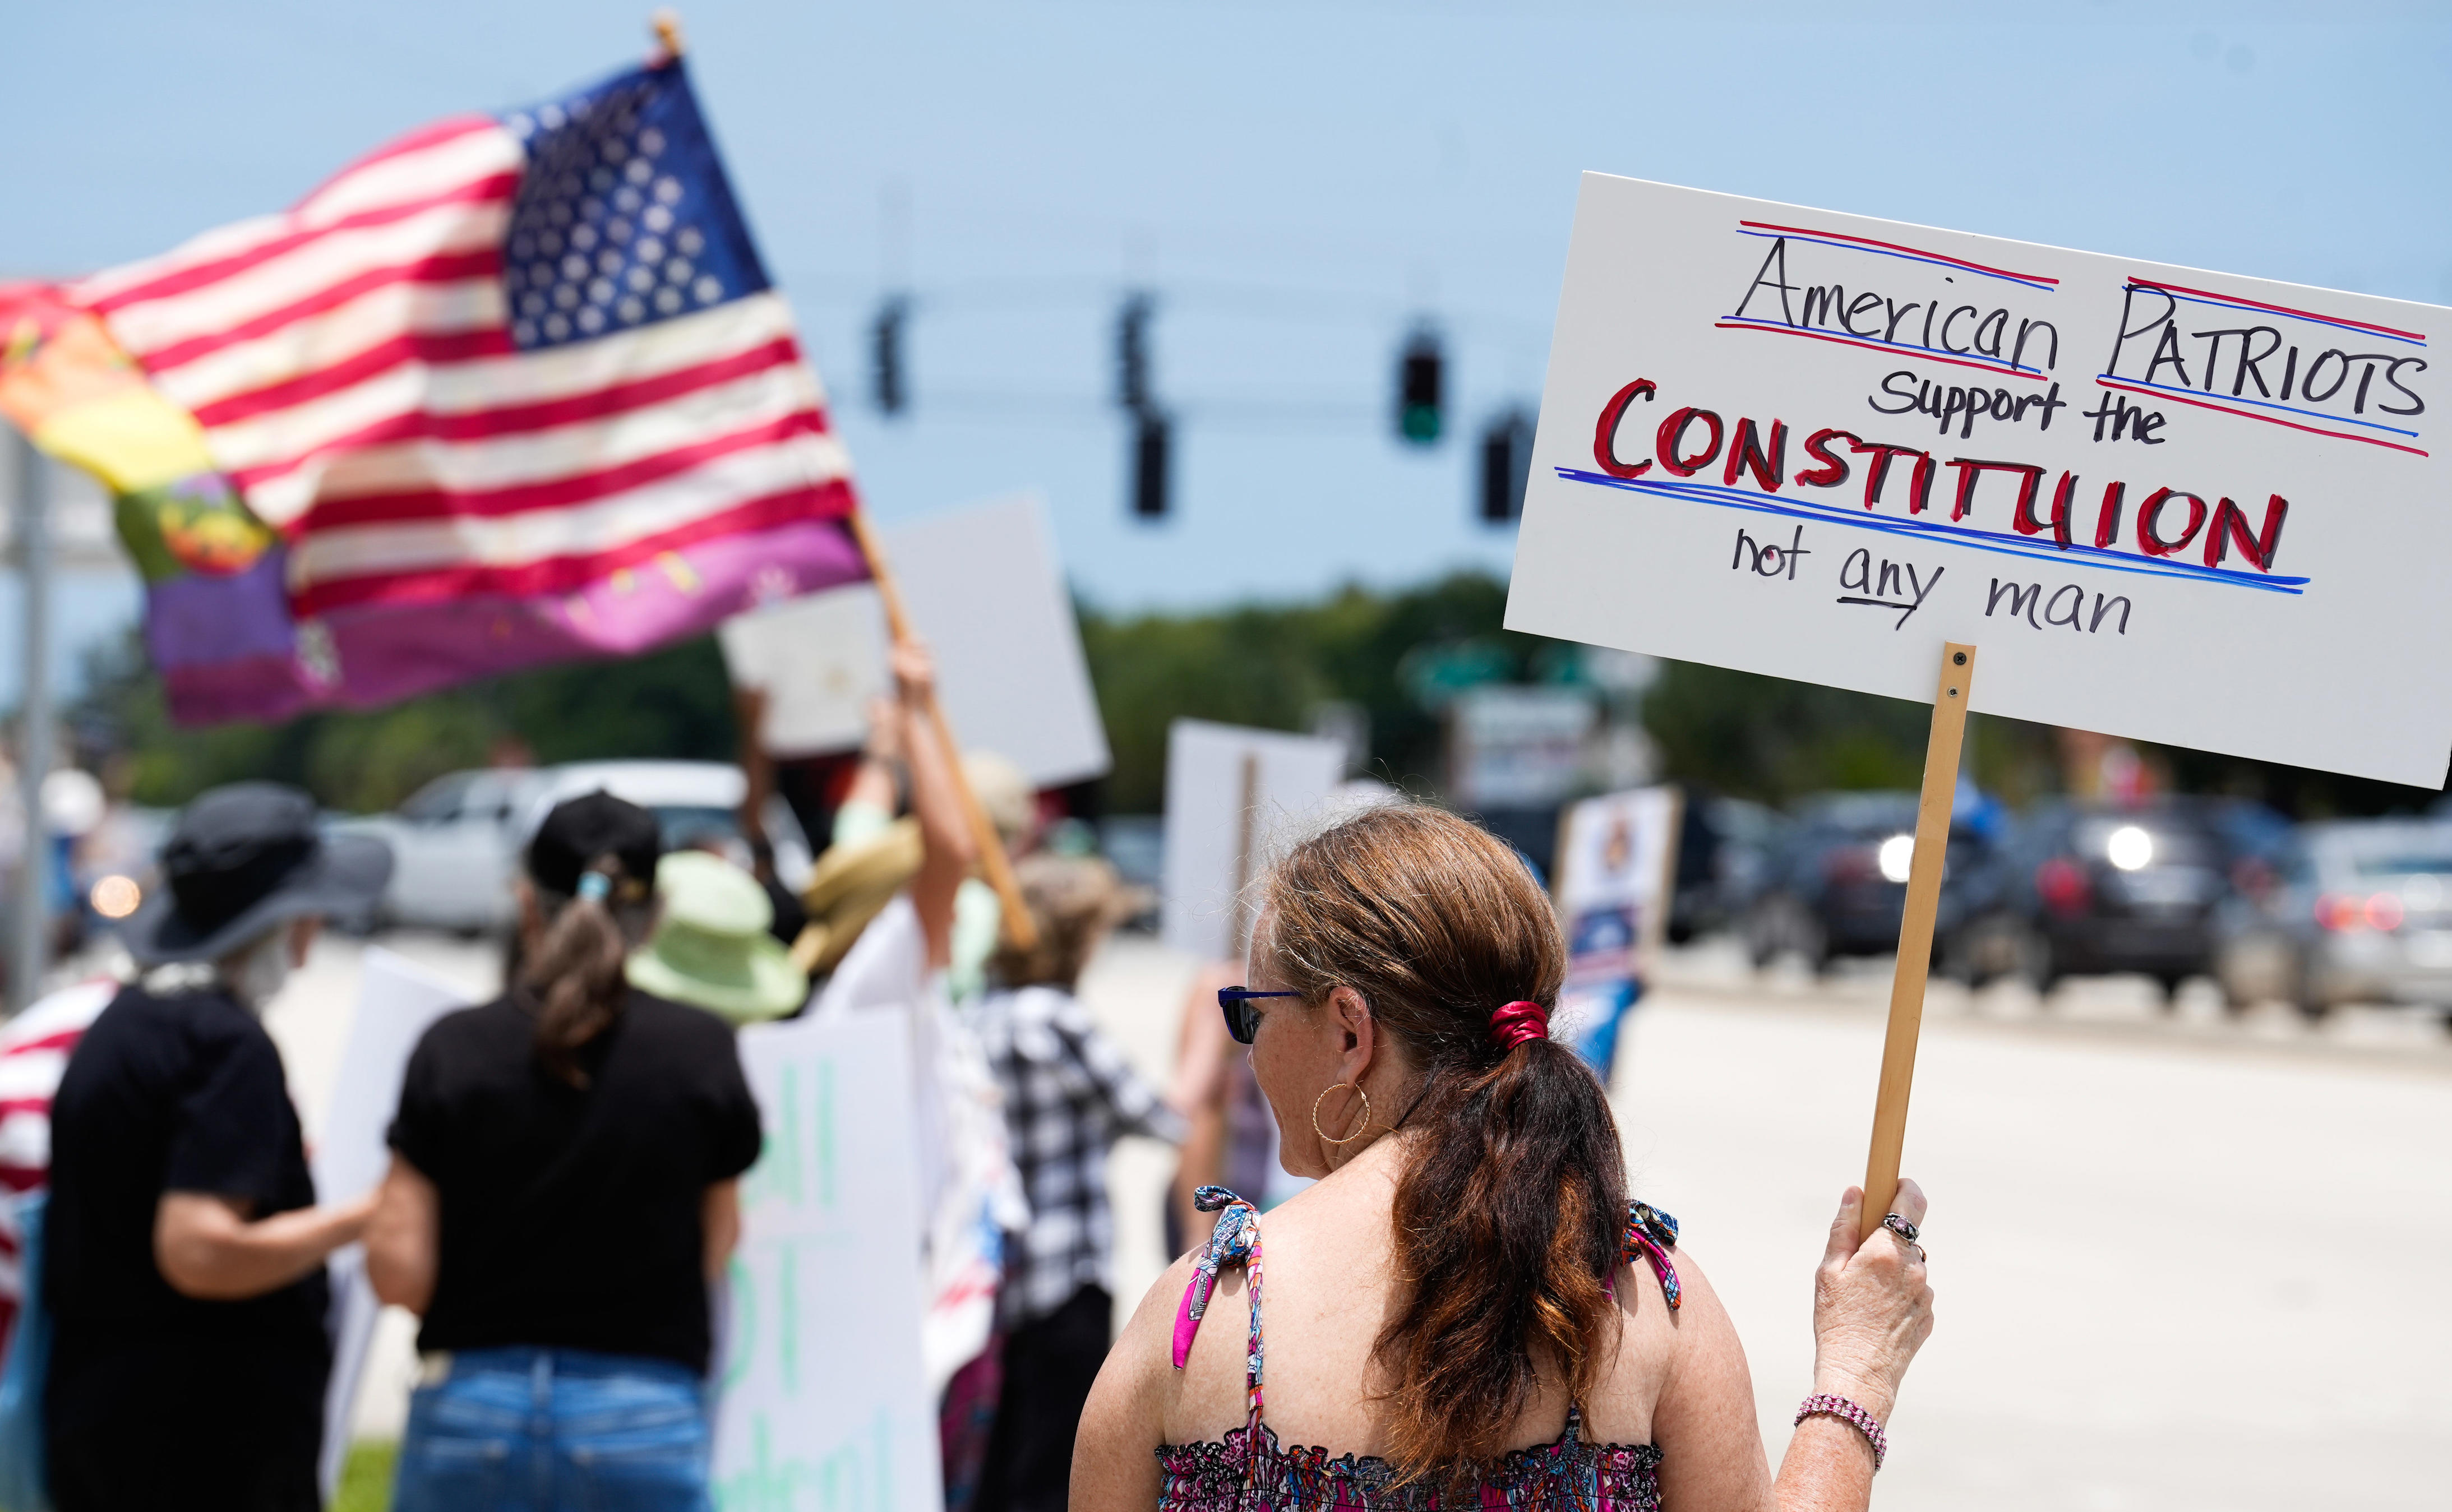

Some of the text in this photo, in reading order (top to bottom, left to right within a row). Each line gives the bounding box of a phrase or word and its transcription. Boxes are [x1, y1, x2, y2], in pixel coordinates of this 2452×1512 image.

[1735, 237, 2428, 415] American PATRIOTS
[1593, 378, 2289, 574] CONSTITUION
[2082, 391, 2168, 445] the
[1733, 525, 2131, 635] not any man
